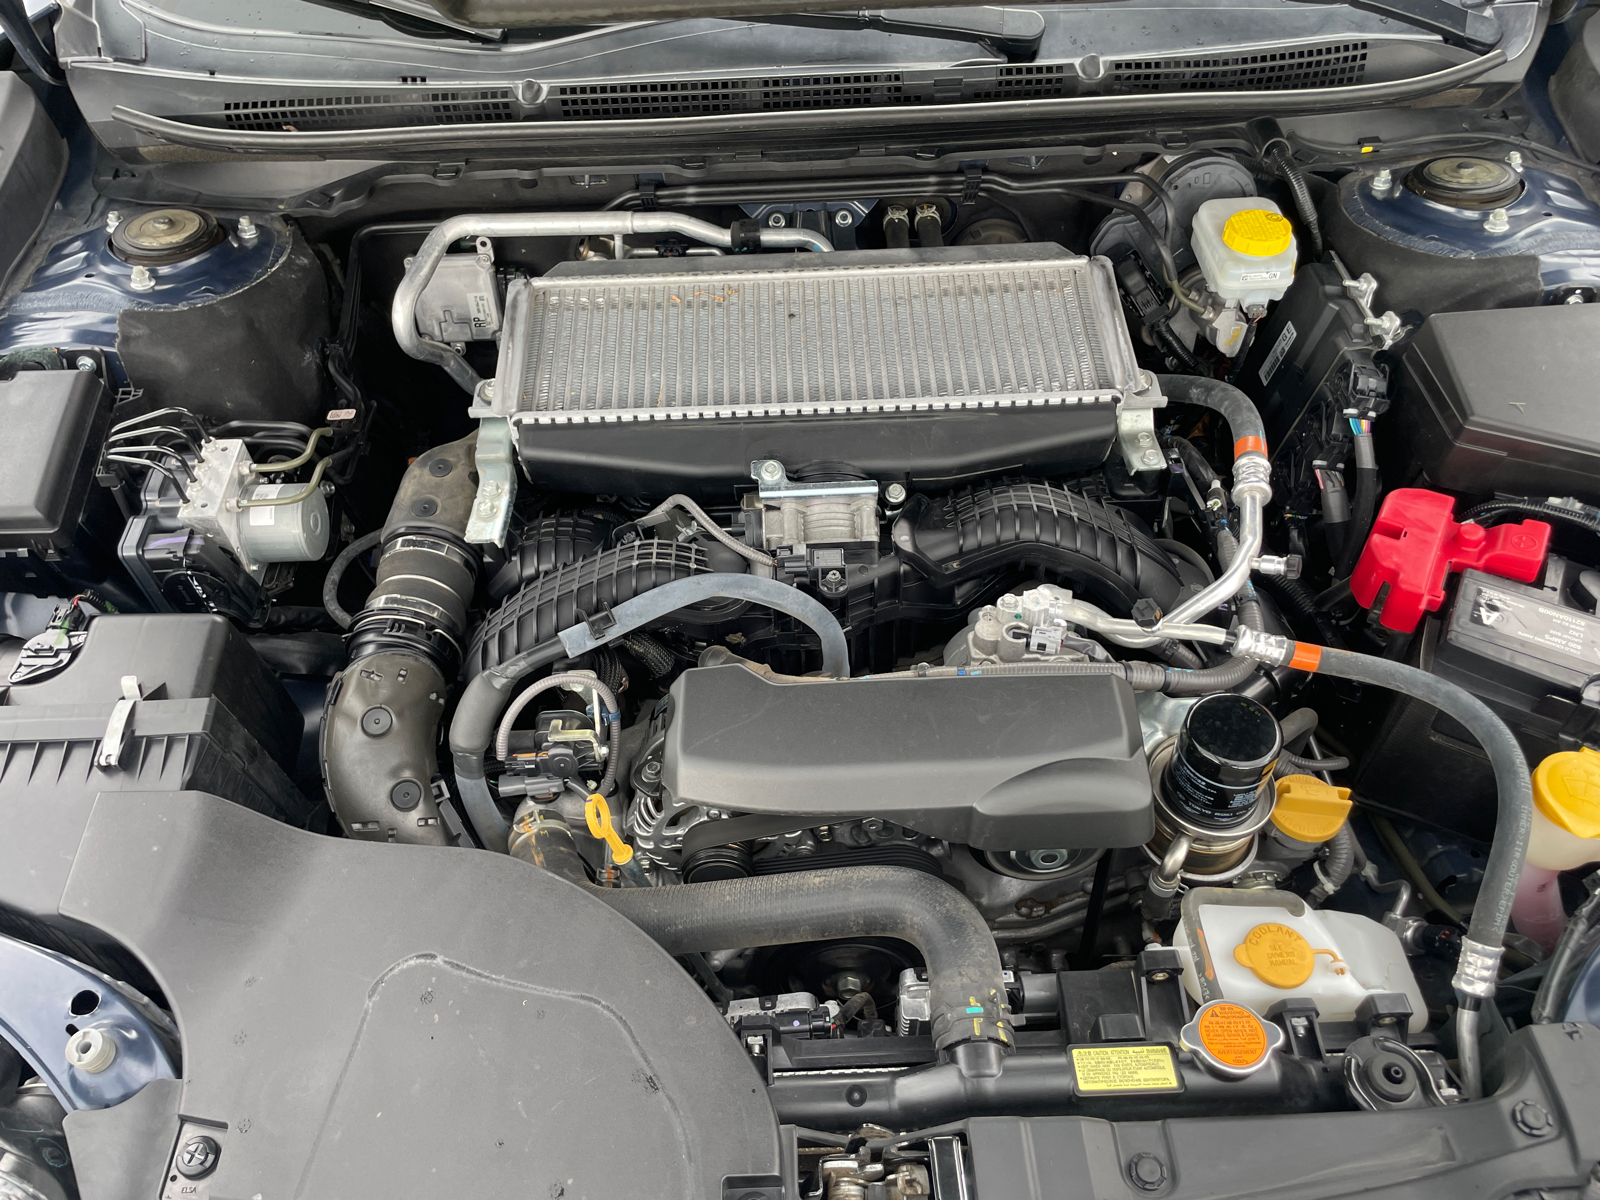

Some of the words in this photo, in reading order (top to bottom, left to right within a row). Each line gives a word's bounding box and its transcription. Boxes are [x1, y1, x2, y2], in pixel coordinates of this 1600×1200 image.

[1562, 633, 1583, 643] GROUP
[1568, 629, 1584, 638] LN2
[1534, 637, 1564, 650] CRANKING
[1544, 634, 1567, 647] AMPS
[1564, 646, 1581, 655] COLD
[1568, 642, 1582, 650] 620
[1249, 925, 1302, 946] COOLANT
[1269, 959, 1298, 967] MANUAL
